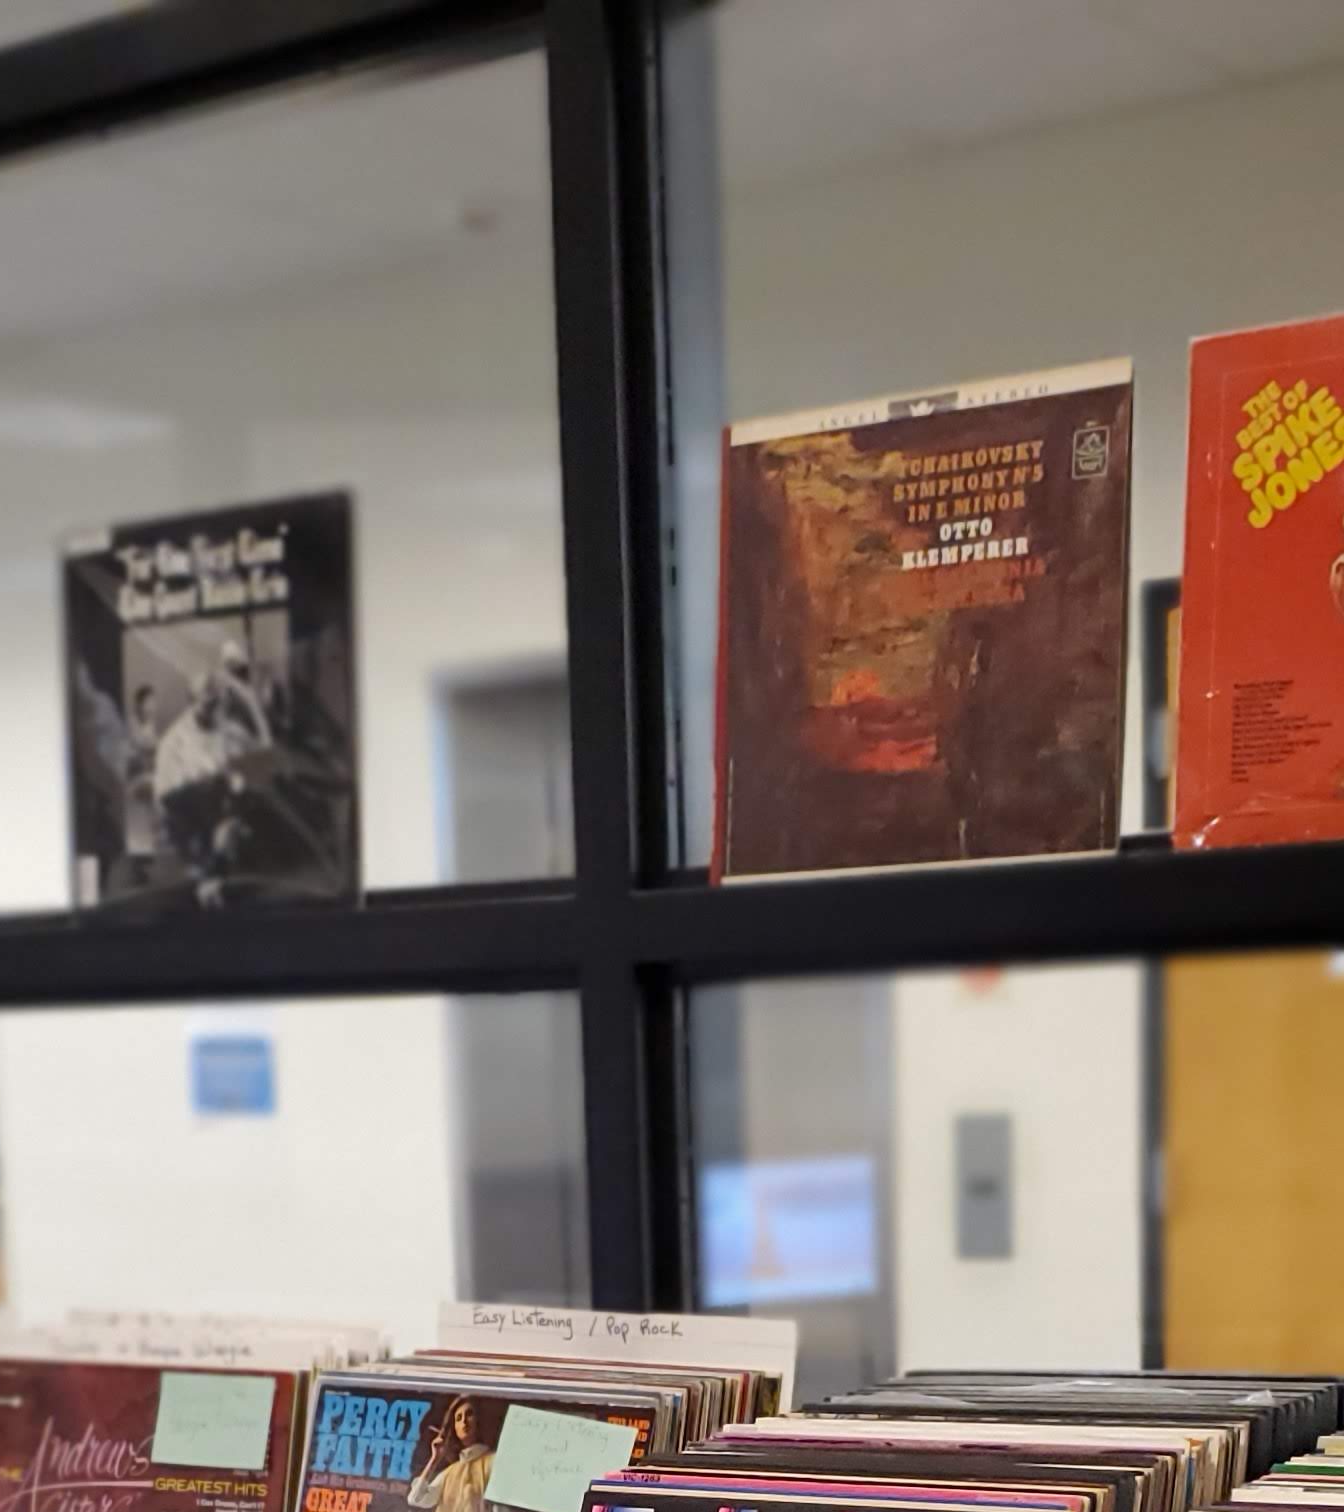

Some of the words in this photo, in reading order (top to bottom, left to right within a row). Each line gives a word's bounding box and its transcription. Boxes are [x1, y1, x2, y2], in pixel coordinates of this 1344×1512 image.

[1235, 402, 1282, 450] BEST
[1282, 379, 1308, 410] OF
[1241, 380, 1282, 418] THE
[1233, 386, 1342, 492] SPIKE
[893, 472, 1007, 502] SYMPHONY
[907, 503, 930, 523] IN
[935, 500, 948, 519] E
[952, 491, 1025, 518] MINOR
[939, 518, 994, 542] OTTO
[901, 537, 1029, 571] KLEMPERER
[472, 1306, 506, 1333] Easy
[512, 1307, 573, 1340] Listening
[606, 1315, 630, 1343] Pop
[639, 1320, 683, 1338] Rock
[318, 1394, 432, 1440] PERCY
[312, 1432, 417, 1480] FAITH
[155, 1477, 232, 1494] GREATEST
[235, 1483, 268, 1497] HITS
